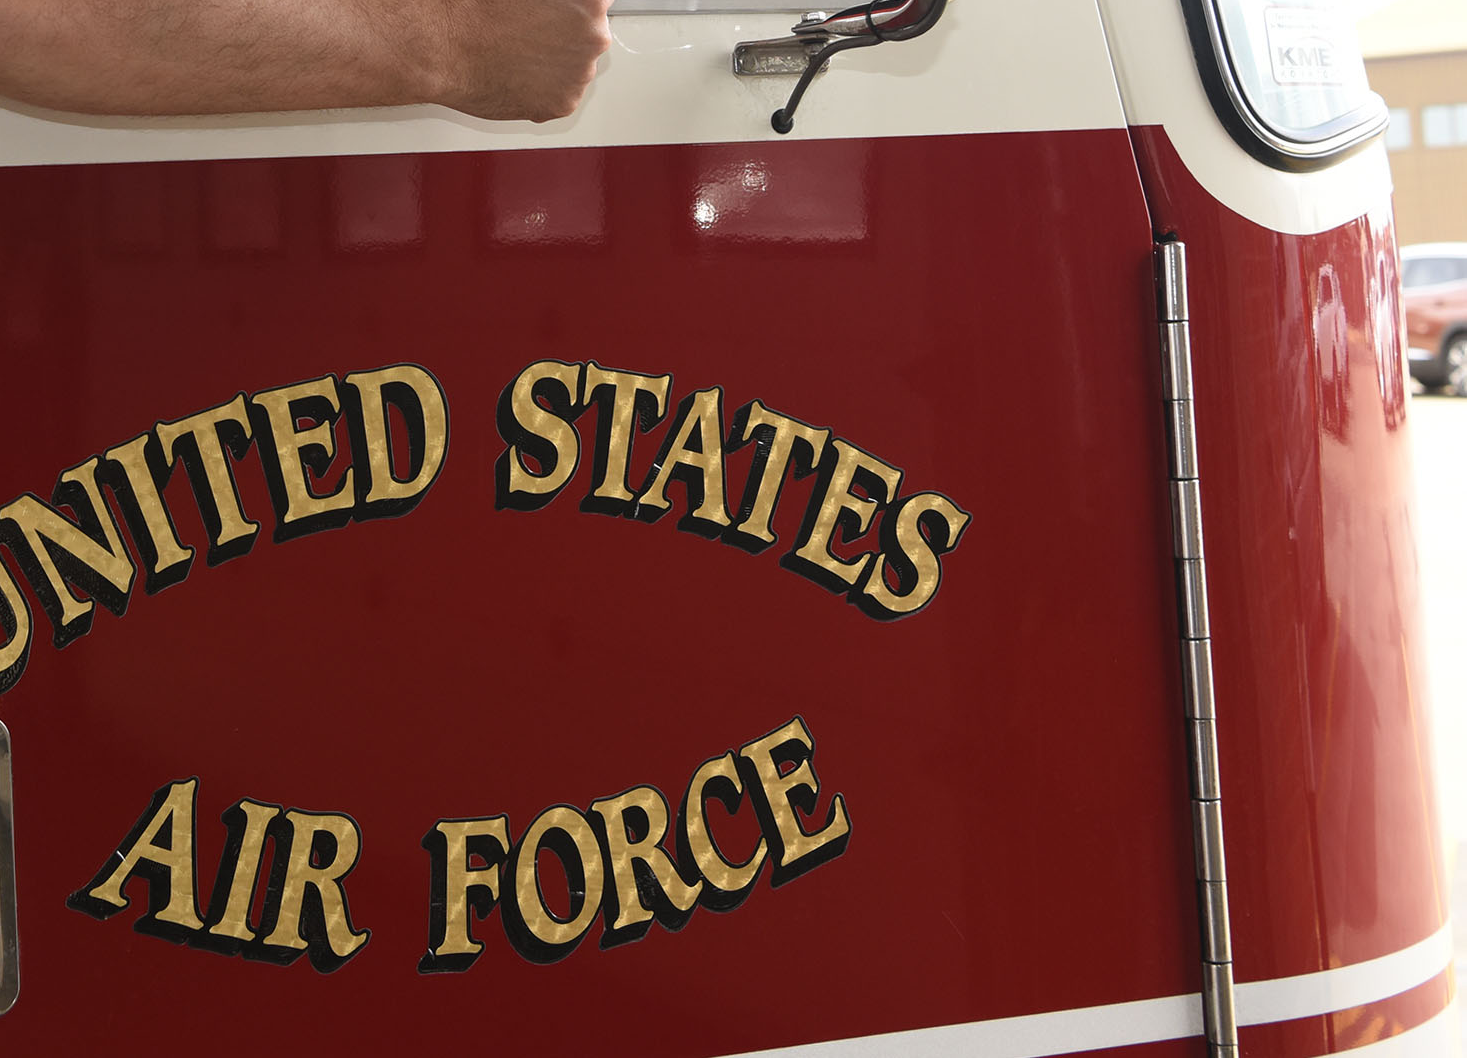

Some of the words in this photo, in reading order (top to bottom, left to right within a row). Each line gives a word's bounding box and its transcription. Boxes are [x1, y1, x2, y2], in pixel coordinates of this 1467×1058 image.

[1277, 46, 1333, 68] KME
[496, 360, 972, 622] STATES
[67, 777, 371, 973] AIR
[418, 714, 850, 975] FORCE
